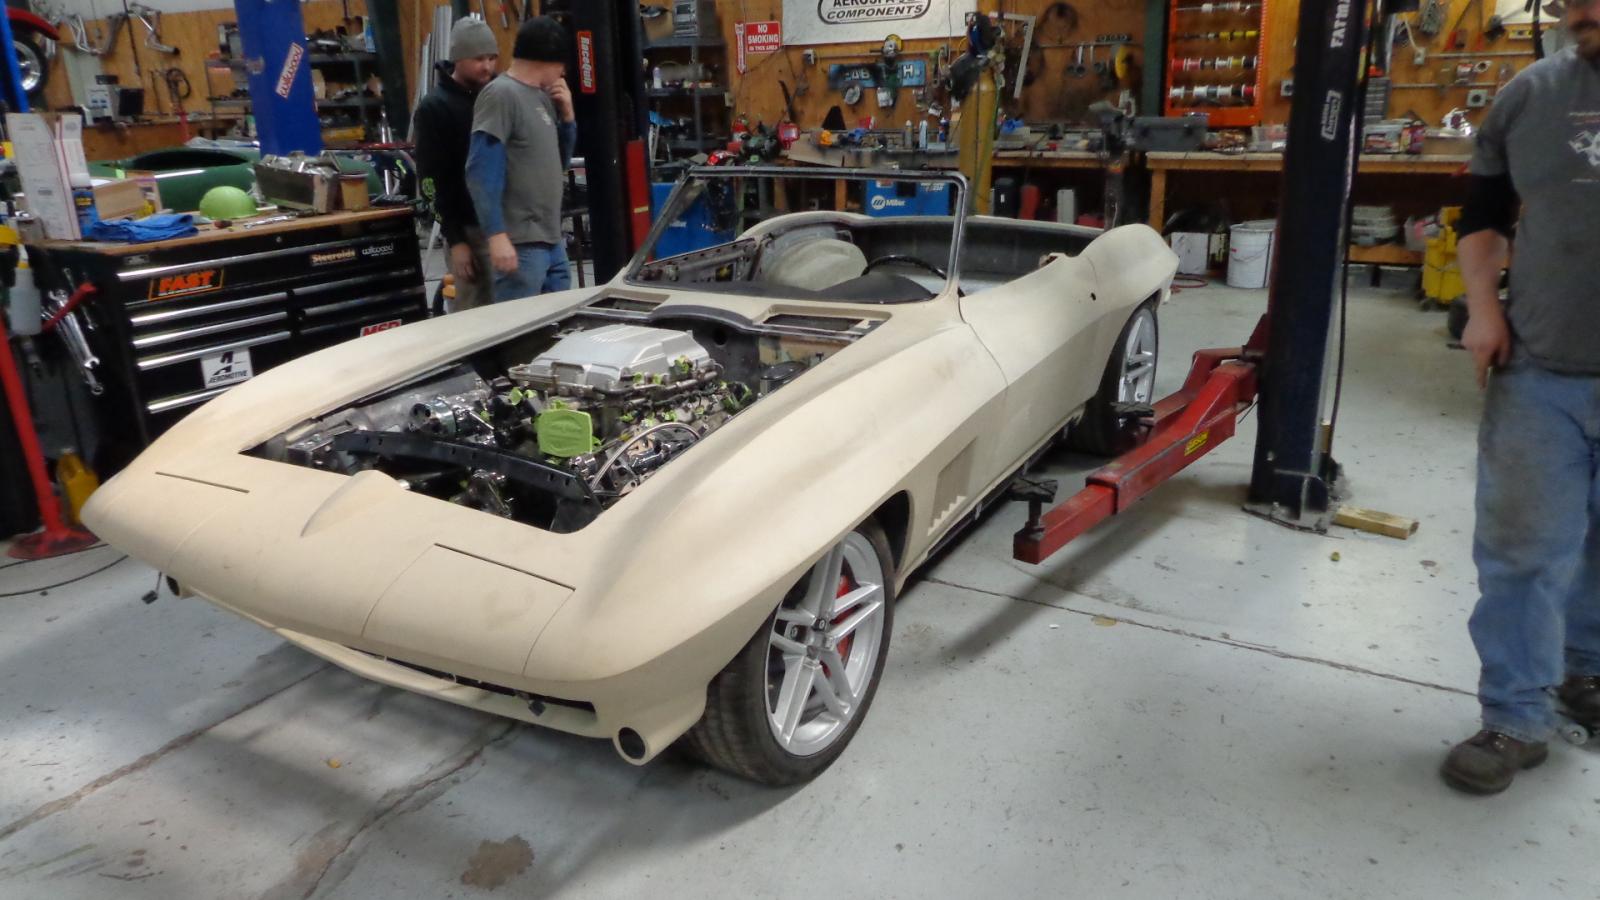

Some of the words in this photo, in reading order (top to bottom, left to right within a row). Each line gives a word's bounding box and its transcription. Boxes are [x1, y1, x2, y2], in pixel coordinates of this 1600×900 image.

[827, 4, 923, 20] COMPONENTS
[757, 24, 768, 33] NO
[1330, 0, 1351, 48] FATM
[747, 33, 779, 44] SMOKING
[580, 36, 592, 88] RaceQuip
[159, 270, 215, 293] FAST
[208, 370, 248, 384] AEROMOTIVE
